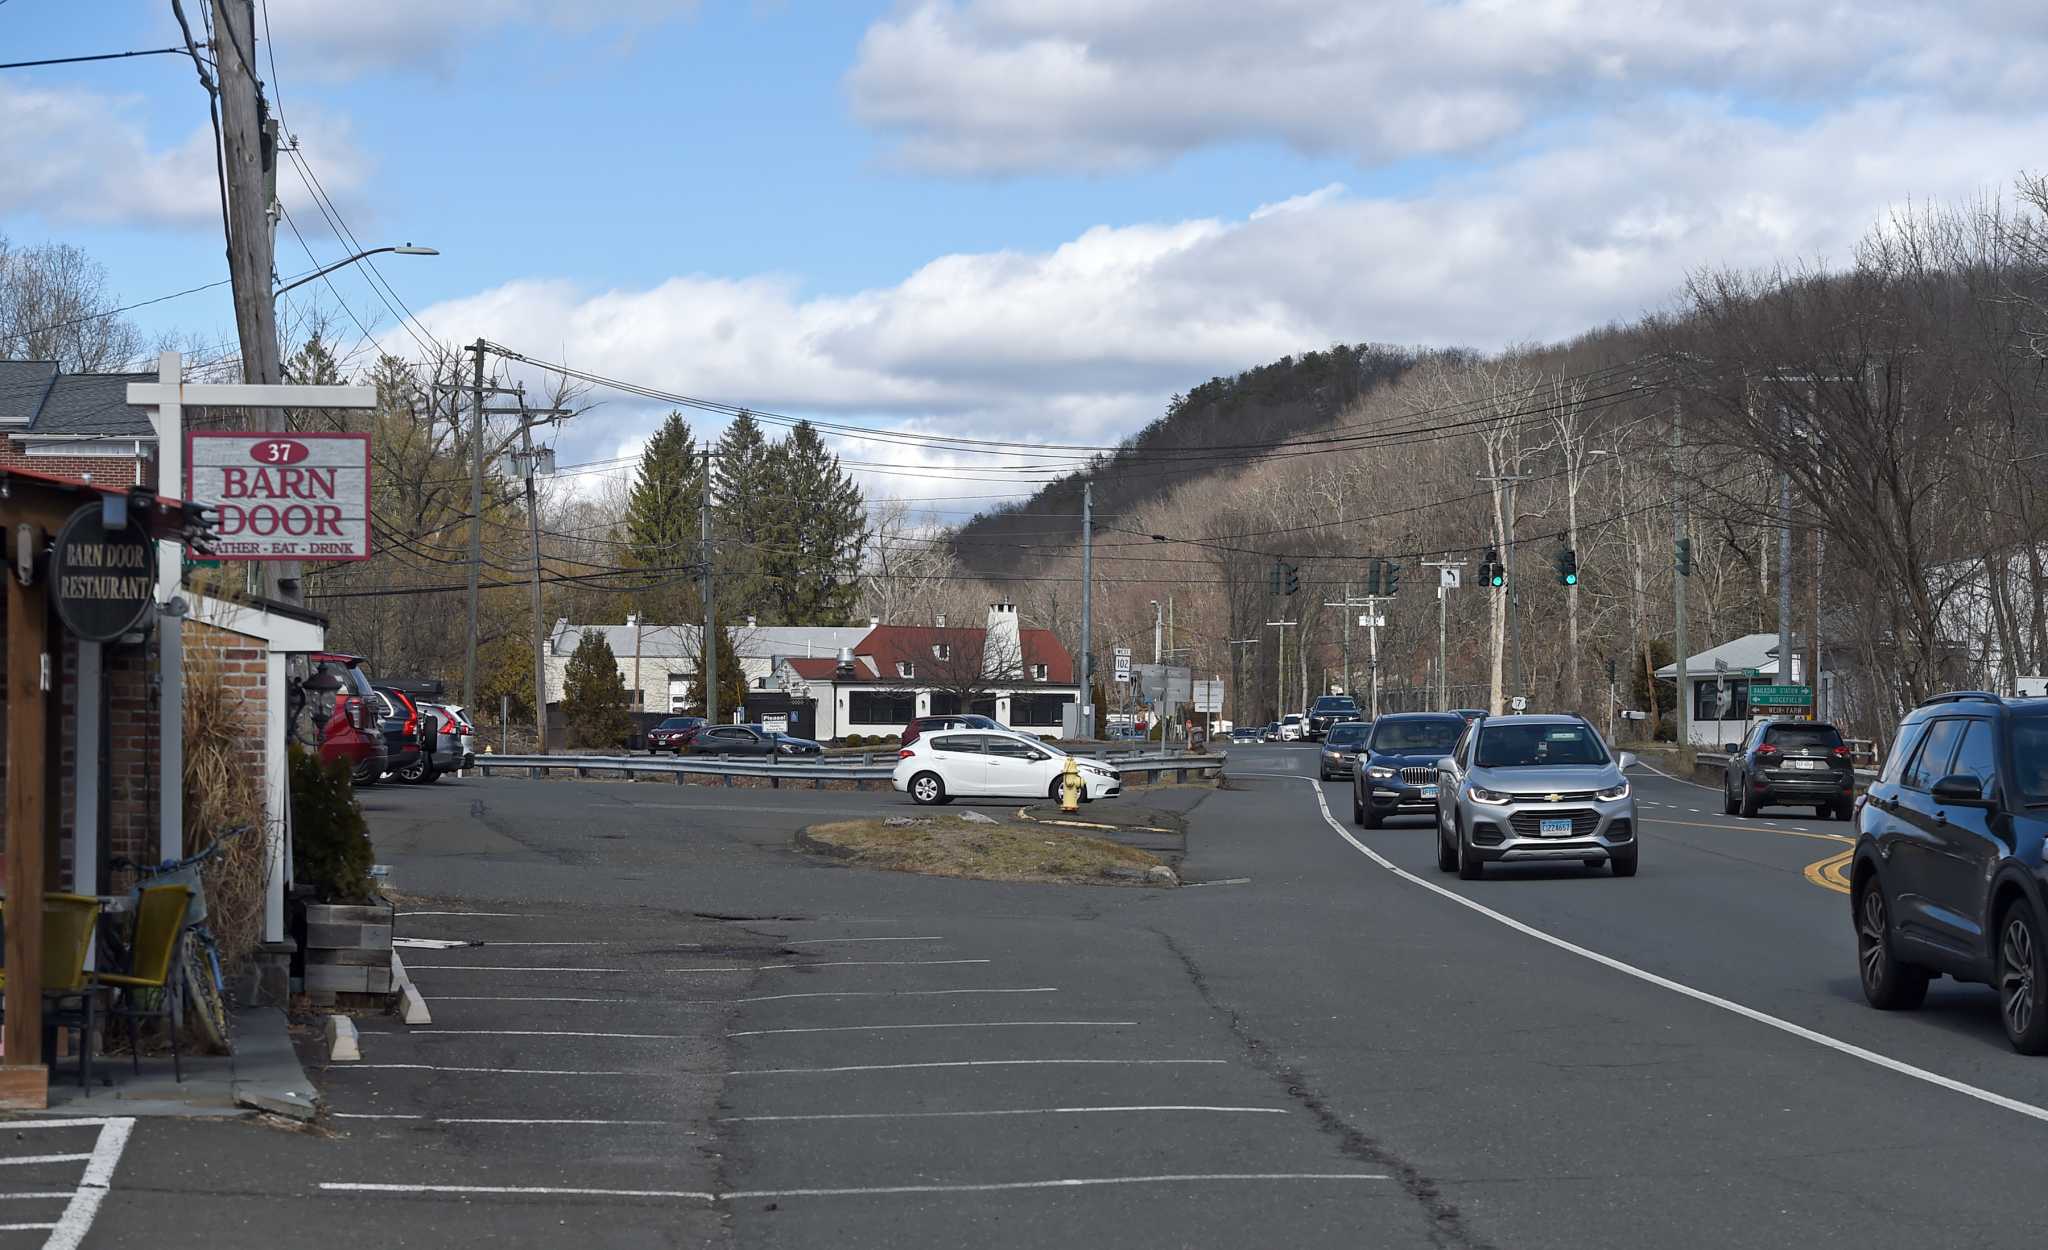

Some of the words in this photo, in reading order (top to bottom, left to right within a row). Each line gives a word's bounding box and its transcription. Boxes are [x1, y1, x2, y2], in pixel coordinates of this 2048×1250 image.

[268, 444, 291, 461] 37
[221, 468, 337, 499] BARN
[215, 504, 344, 536] DOOR
[67, 544, 102, 567] BARN
[106, 544, 144, 568] DOOR
[271, 543, 298, 553] EAT
[309, 543, 354, 554] DRINK
[61, 576, 150, 599] RESTAURANT
[1117, 658, 1129, 669] 102
